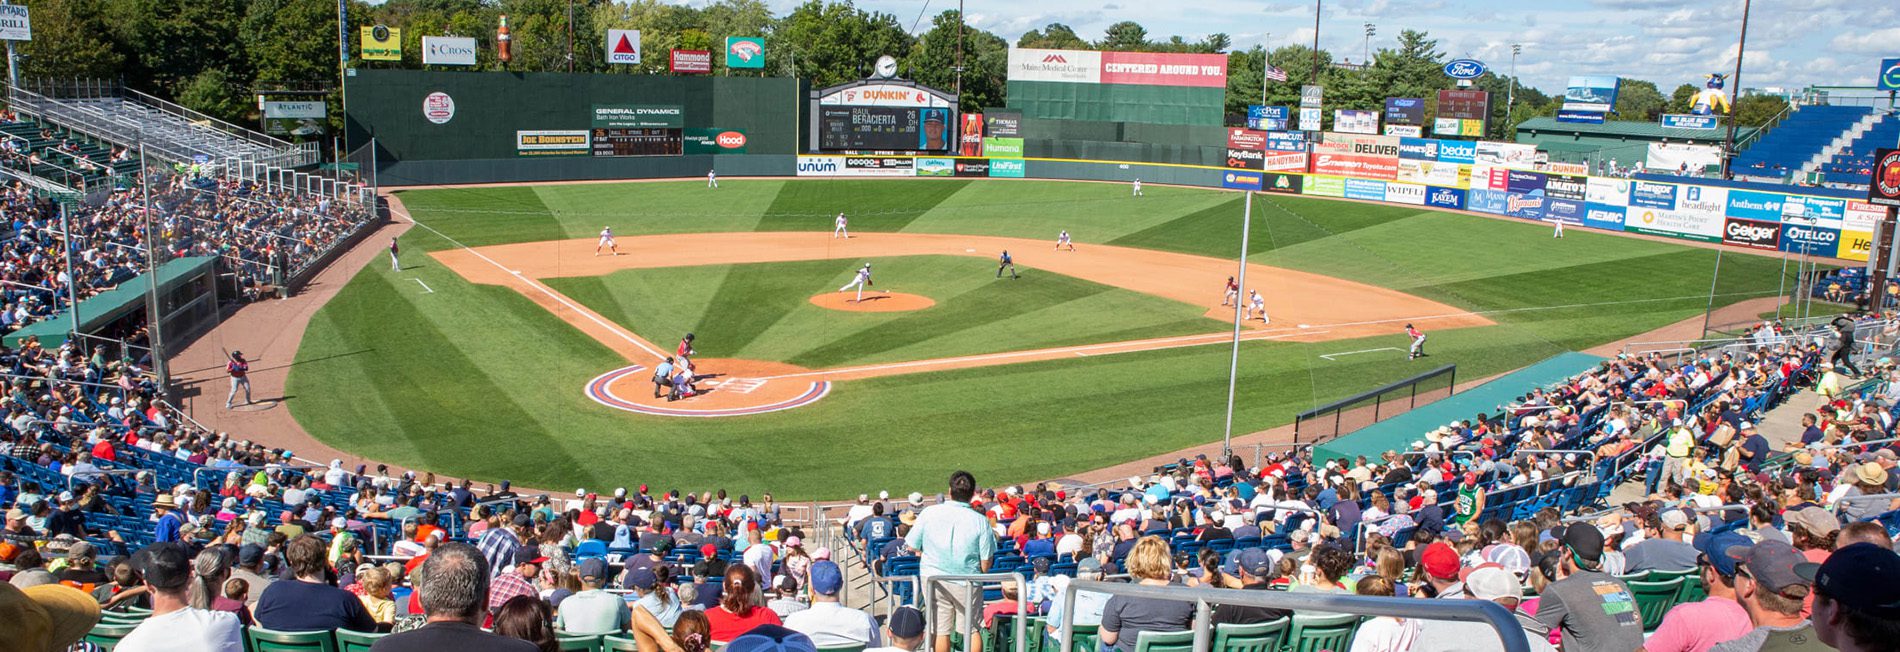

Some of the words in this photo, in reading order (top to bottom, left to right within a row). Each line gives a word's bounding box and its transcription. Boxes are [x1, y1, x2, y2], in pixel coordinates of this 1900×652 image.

[0, 19, 27, 28] RILL
[674, 51, 710, 61] Hammond
[1042, 64, 1066, 72] Medical
[1105, 62, 1158, 74] CENTERED
[1160, 64, 1199, 75] AROUND
[1201, 65, 1223, 76] YOU.
[1451, 63, 1476, 75] Ford
[863, 90, 910, 100] DUNKIN'
[522, 135, 537, 144] JOE
[538, 135, 585, 144] BORNSTEIN
[720, 135, 743, 144] Hood
[986, 144, 1019, 153] Humana
[1228, 149, 1263, 160] KeyBank
[1355, 143, 1398, 156] DELIVER
[799, 158, 836, 172] unum
[992, 162, 1022, 170] UniFirst
[1267, 154, 1304, 166] HANDYMAN
[1546, 180, 1585, 193] AMATO'S
[1636, 181, 1673, 194] Bangor
[1432, 192, 1458, 206] KAYEM
[1730, 198, 1762, 210] Anthem
[1682, 200, 1721, 213] headlight
[1587, 209, 1623, 223] MEMIC
[1727, 222, 1776, 241] Geiger
[1788, 226, 1836, 242] OTELCO
